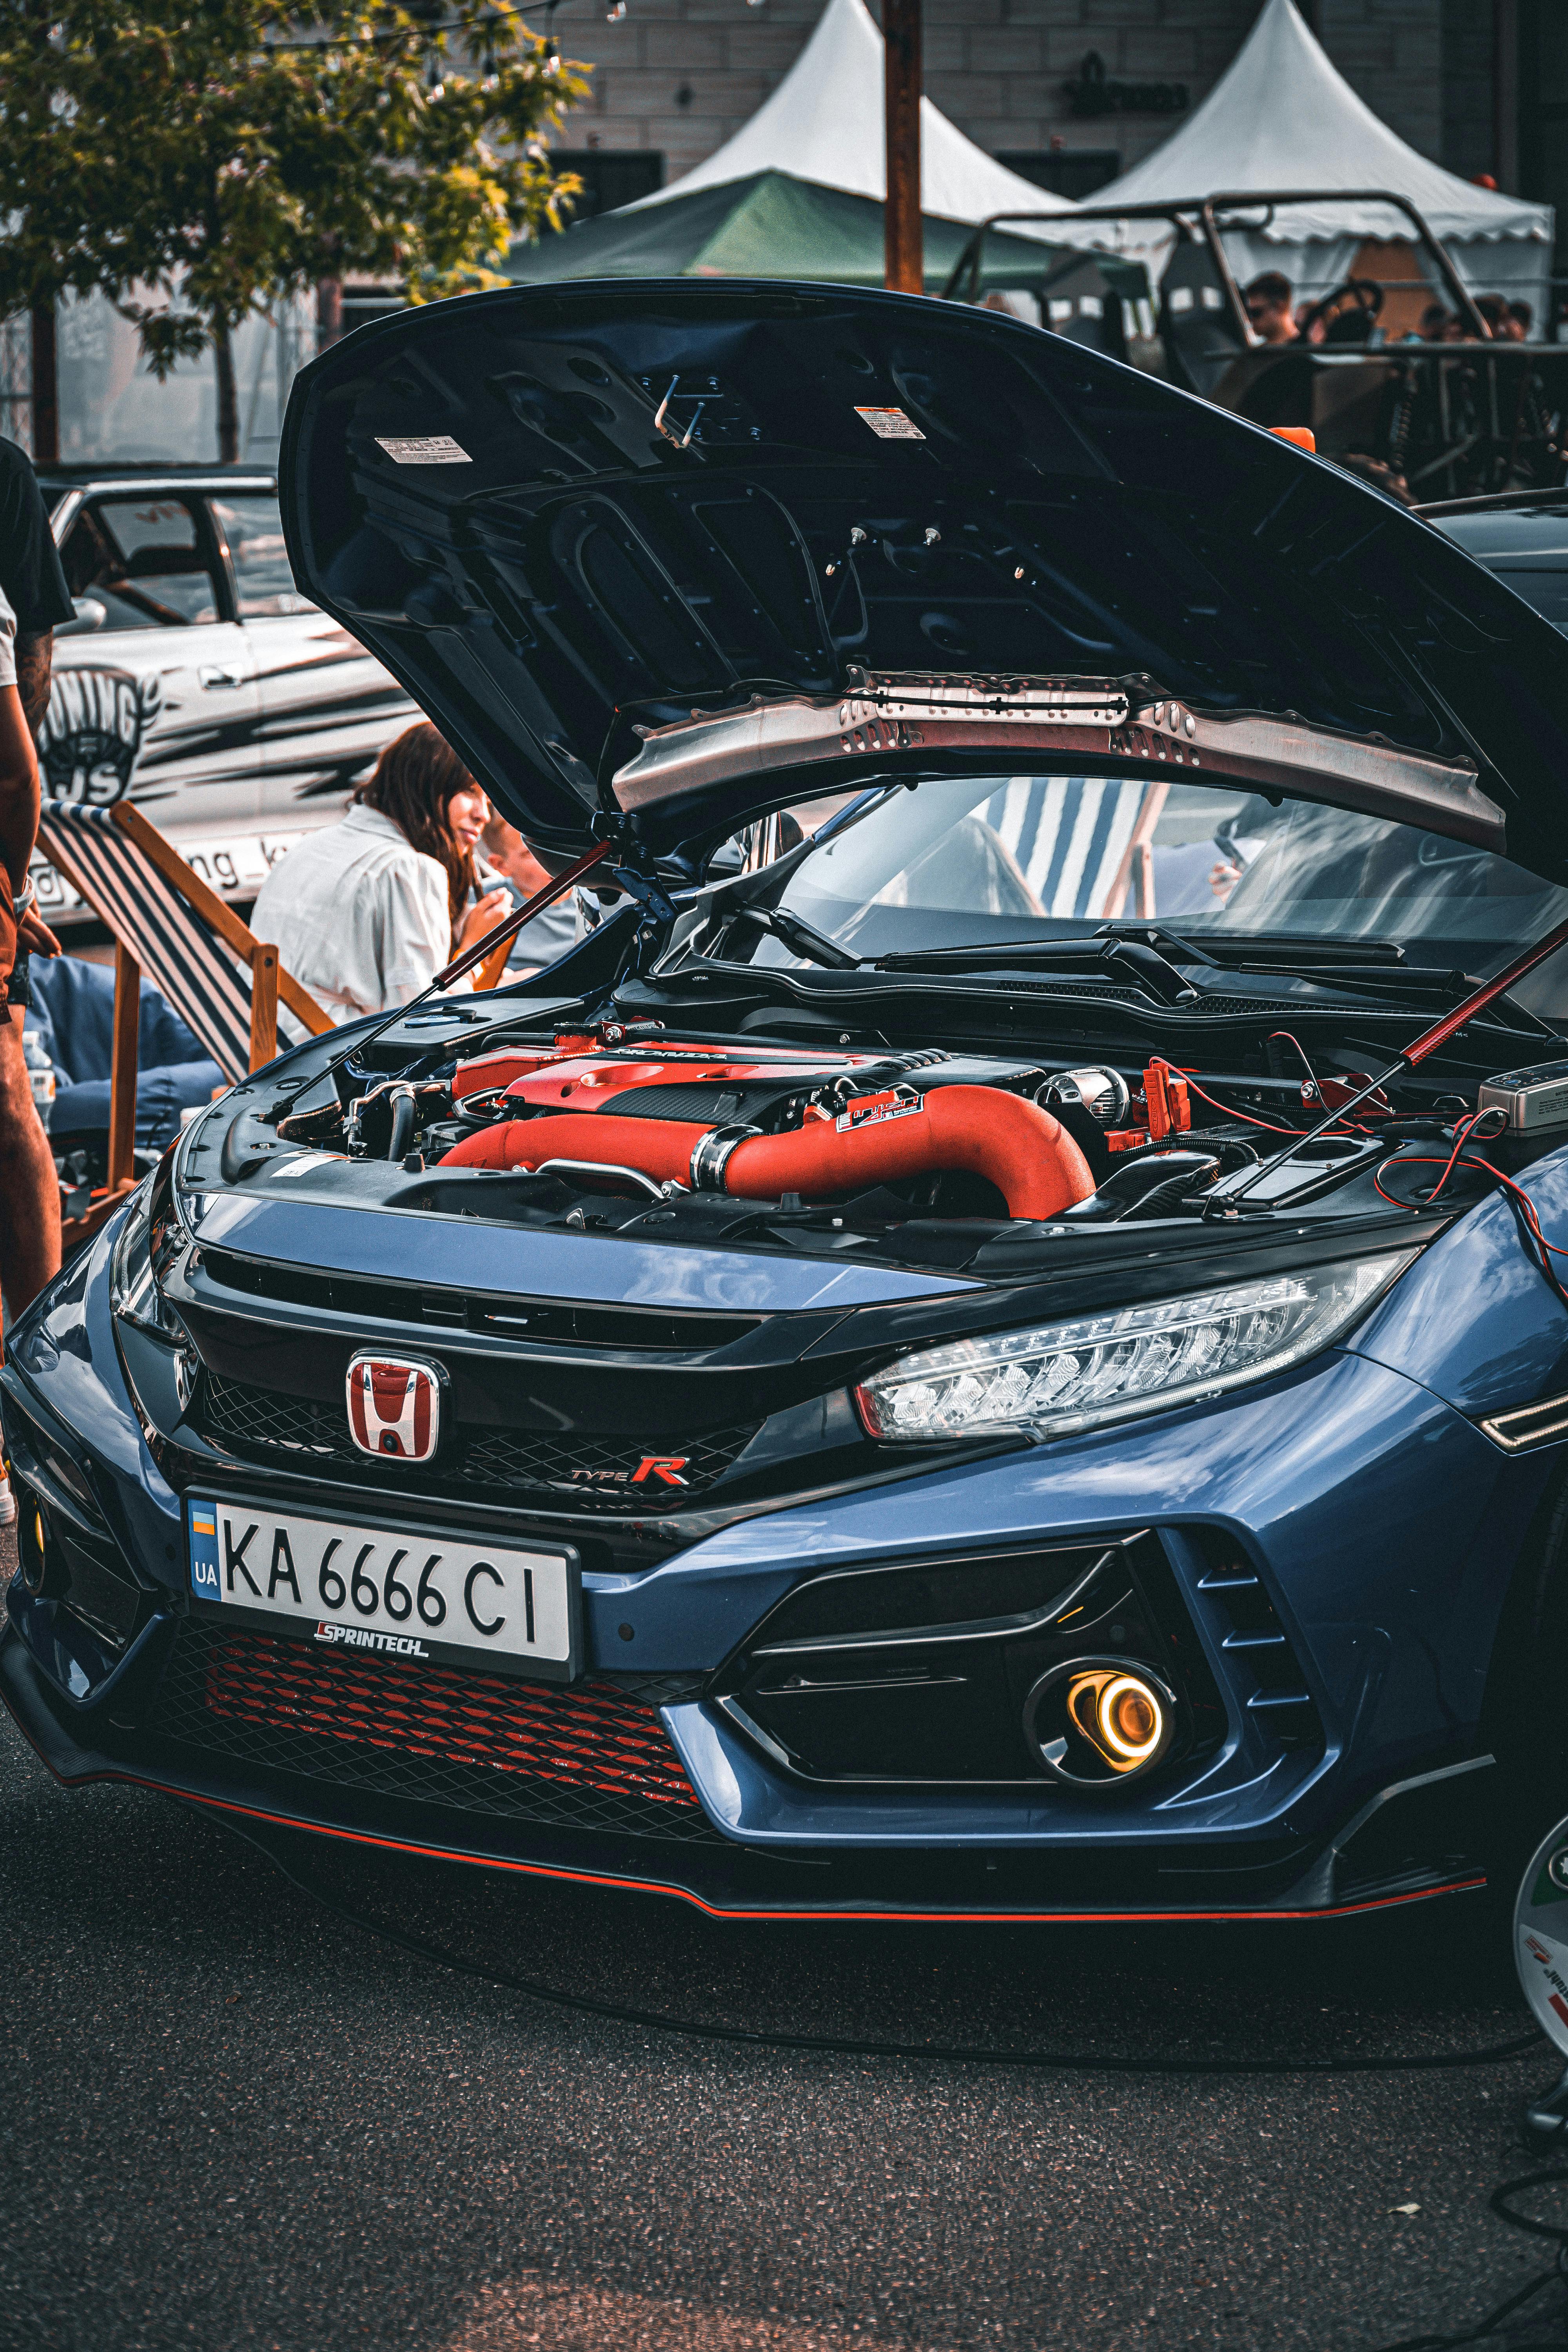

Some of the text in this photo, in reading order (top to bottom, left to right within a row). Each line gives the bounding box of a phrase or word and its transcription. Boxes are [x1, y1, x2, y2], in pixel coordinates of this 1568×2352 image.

[55, 762, 120, 804] JS
[608, 1048, 728, 1060] HONDA
[572, 1456, 690, 1485] TYPE R
[195, 1561, 217, 1586] UA
[223, 1519, 535, 1643] KA 6666 CI
[314, 1624, 429, 1657] SPRINTECH
